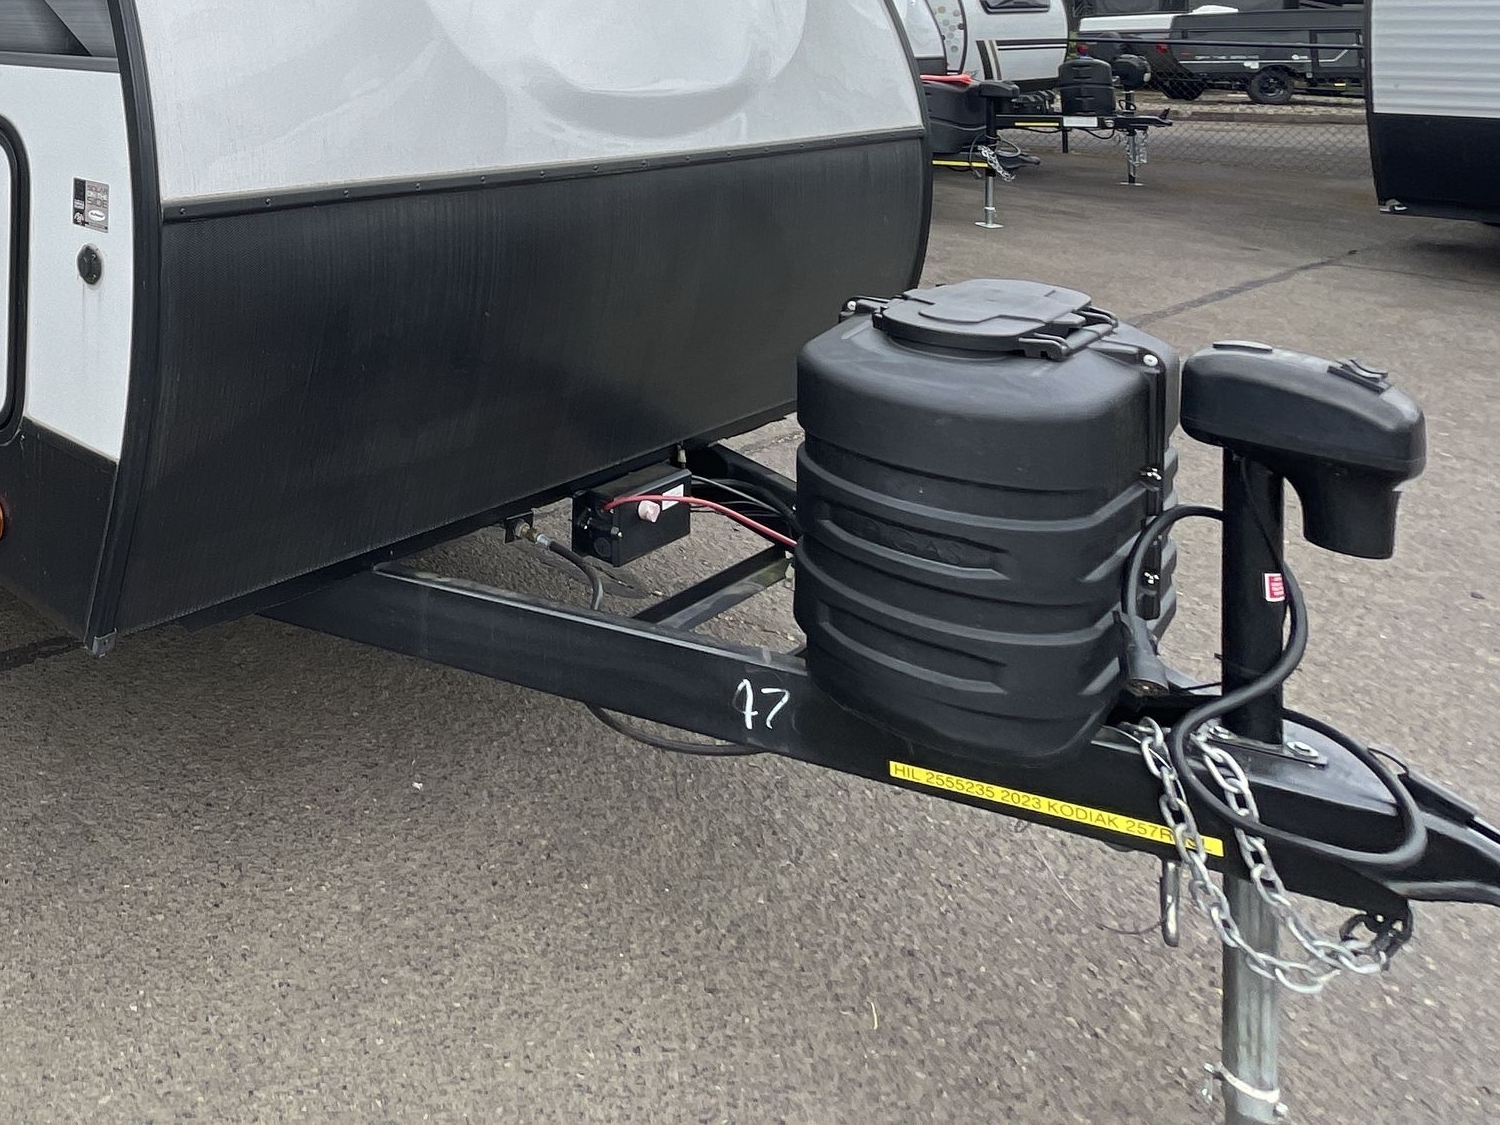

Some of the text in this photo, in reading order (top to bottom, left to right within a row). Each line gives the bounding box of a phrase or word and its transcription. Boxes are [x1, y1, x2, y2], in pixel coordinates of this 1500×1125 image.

[894, 763, 921, 781] HIL
[925, 771, 996, 799] 2555235
[1000, 789, 1042, 810] 2023
[1047, 801, 1120, 829] KODIAK
